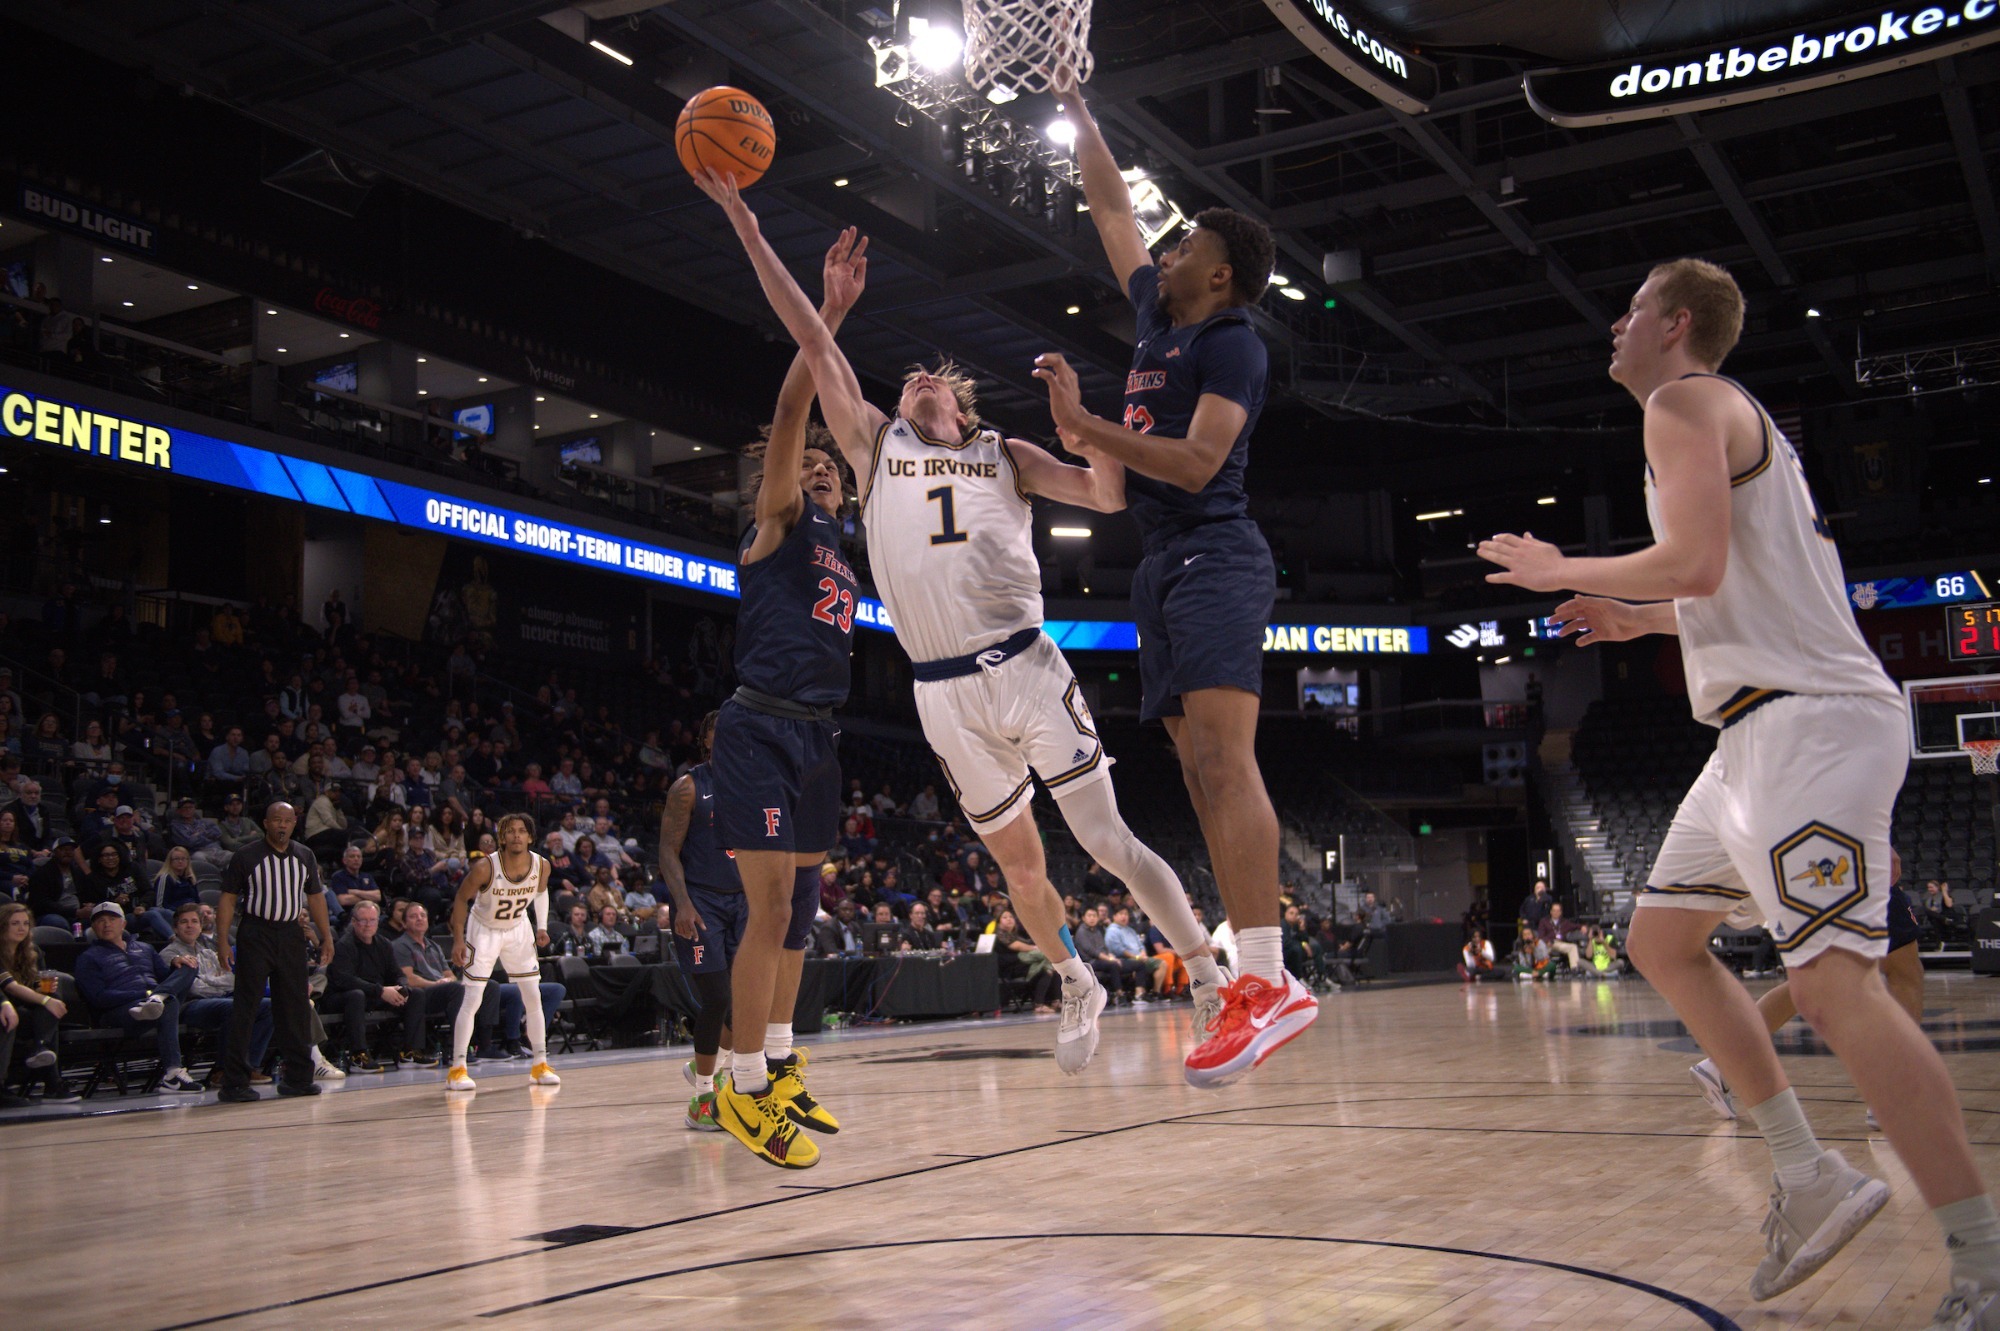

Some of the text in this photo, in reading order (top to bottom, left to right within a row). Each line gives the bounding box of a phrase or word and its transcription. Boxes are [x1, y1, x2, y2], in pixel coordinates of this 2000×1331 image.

[1306, 0, 1407, 79] oke.com
[1609, 0, 2000, 98] dontbebroke.c
[25, 189, 153, 249] BUD LIGHT
[543, 369, 575, 388] RESORT
[2, 393, 171, 469] CENTER
[887, 458, 997, 478] UC IRVINE
[926, 484, 969, 546] 1
[426, 499, 510, 541] OFFICIAL
[514, 519, 622, 566] SHORT-TERM
[625, 545, 684, 580] LENDER
[687, 560, 707, 584] OF
[708, 565, 736, 591] THE
[1936, 576, 1965, 598] 66
[811, 576, 854, 634] 23
[520, 623, 560, 645] never
[1314, 626, 1410, 652] CENTER
[762, 807, 781, 837] F
[1325, 850, 1336, 870] F
[1537, 861, 1547, 878] A
[492, 886, 536, 896] UC IRVINE
[494, 898, 528, 920] 22
[692, 945, 705, 965] F
